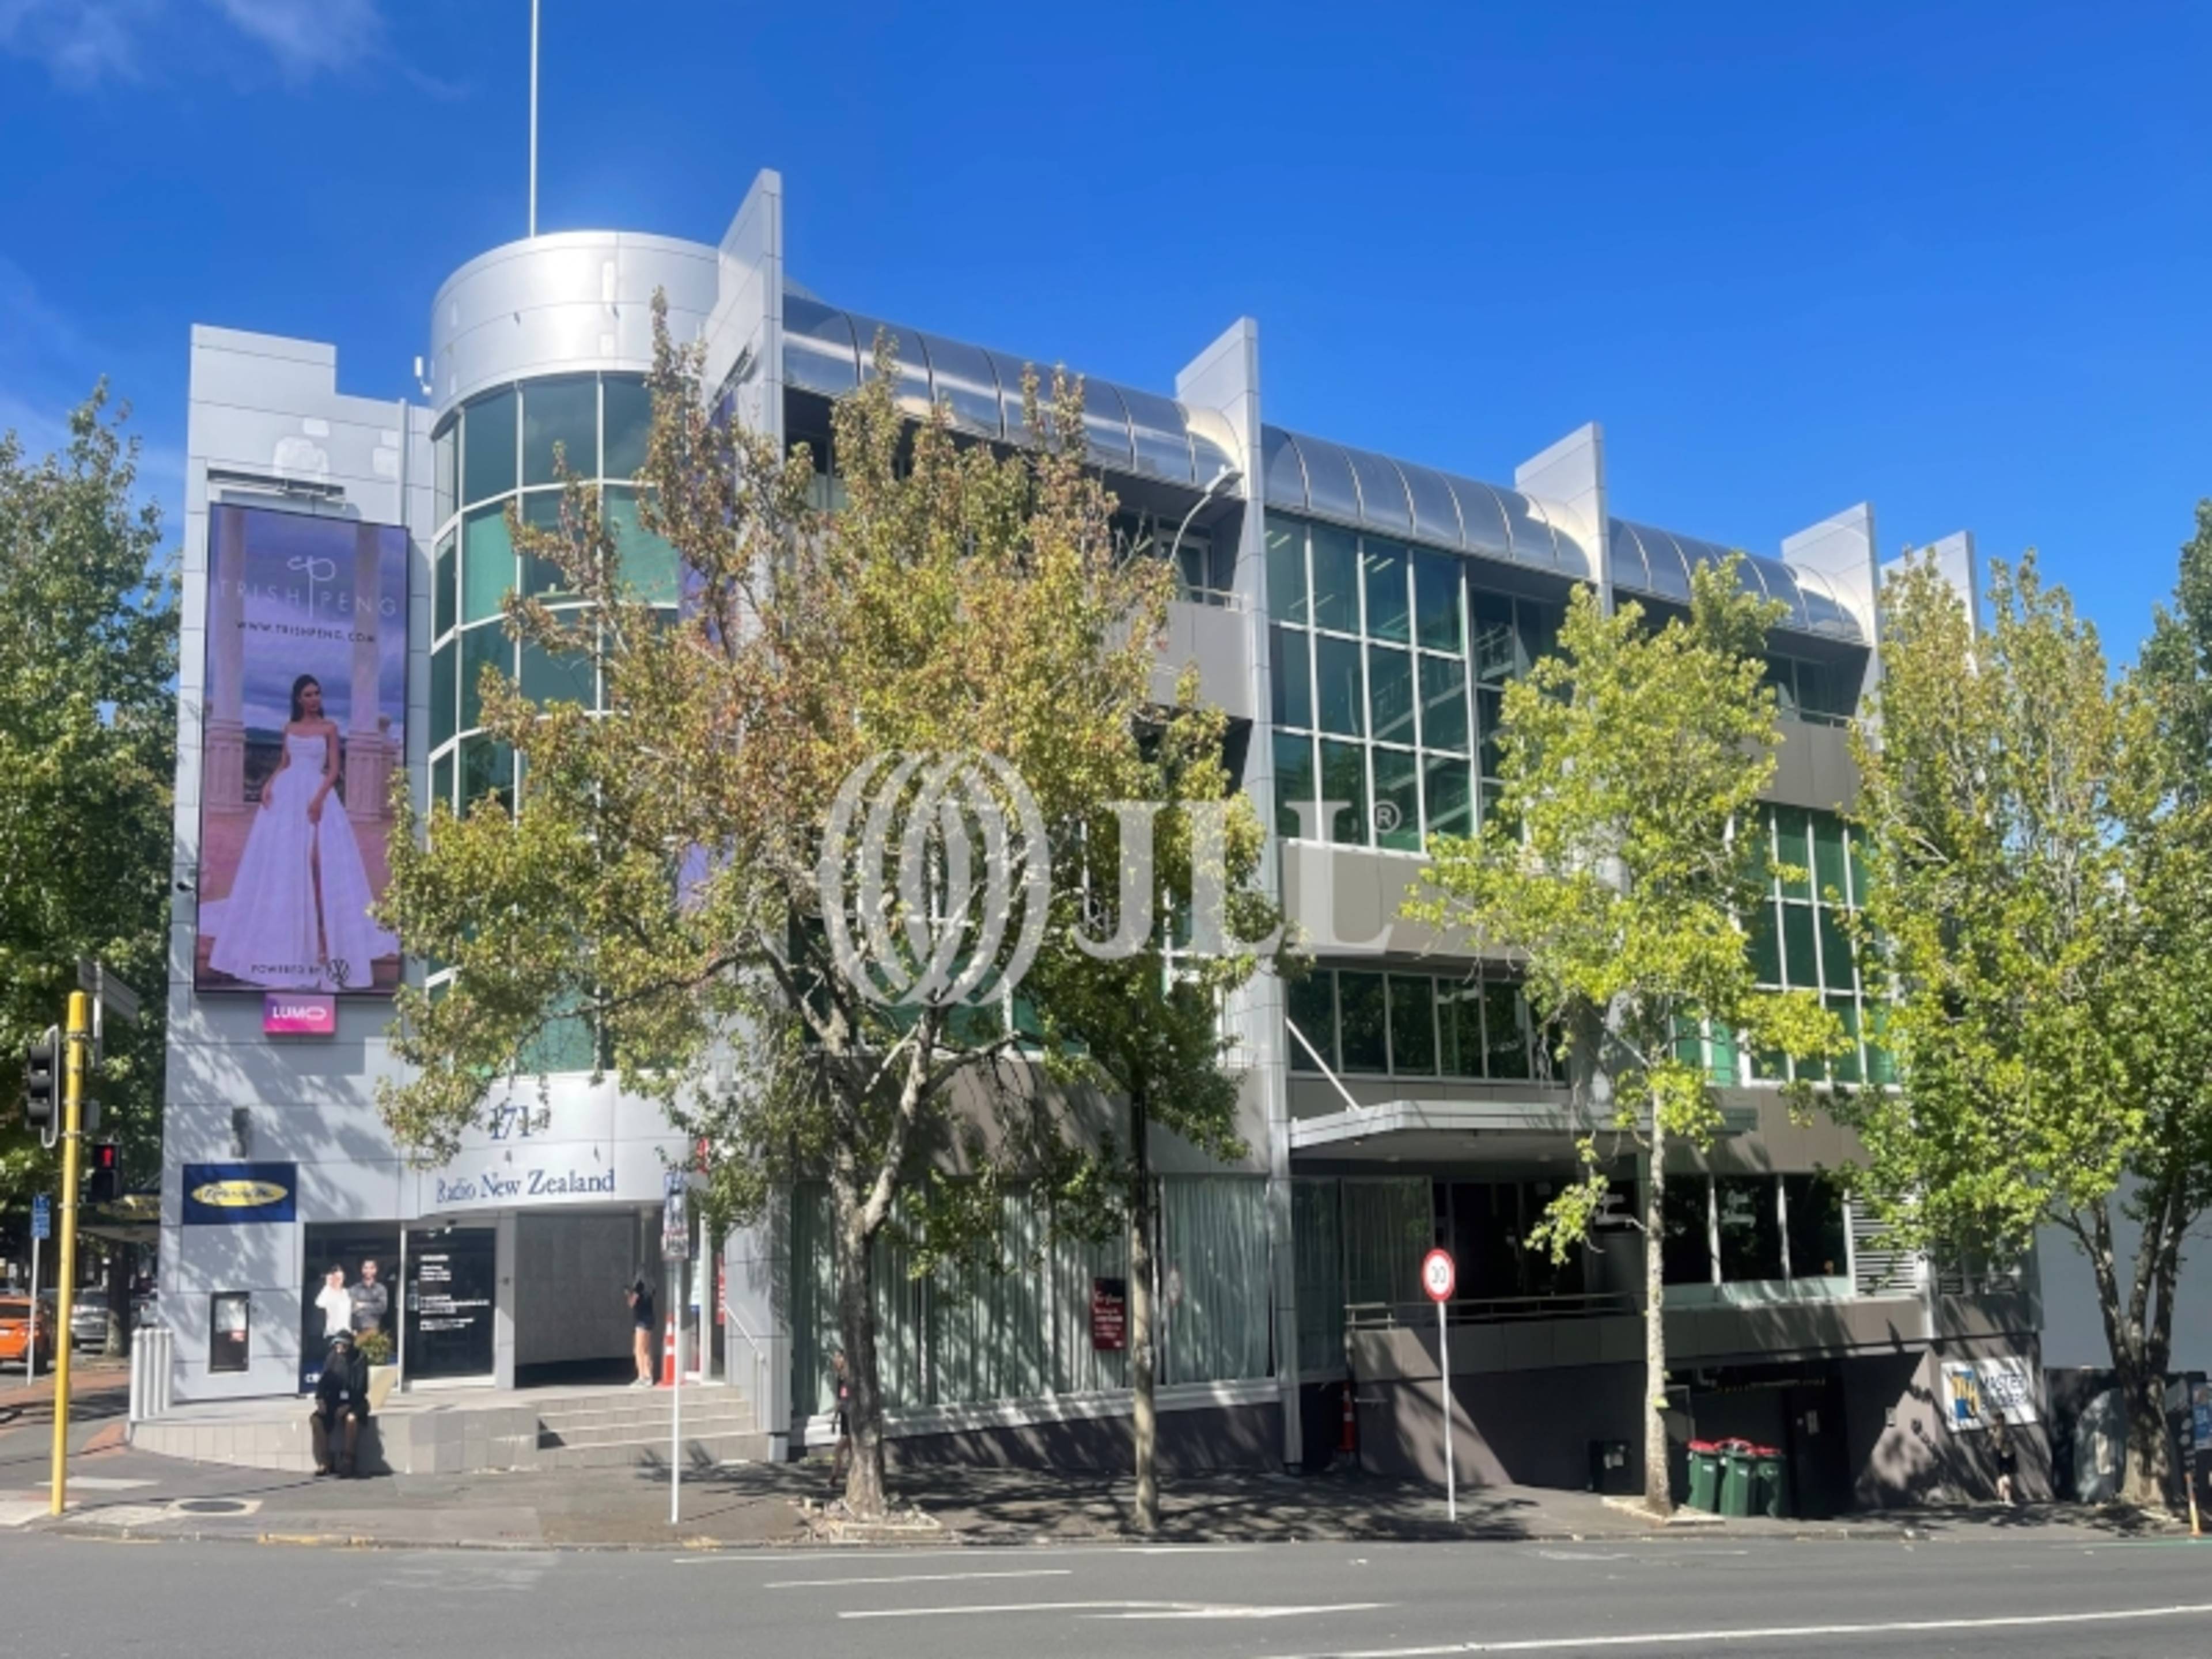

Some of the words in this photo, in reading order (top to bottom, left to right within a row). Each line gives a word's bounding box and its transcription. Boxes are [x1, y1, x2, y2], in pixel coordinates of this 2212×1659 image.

[218, 578, 300, 605] TRISH
[320, 591, 396, 616] PENG
[272, 1006, 327, 1021] LUMO
[436, 1178, 476, 1203] Radio
[480, 1172, 521, 1198] New
[527, 1168, 615, 1196] Zealand
